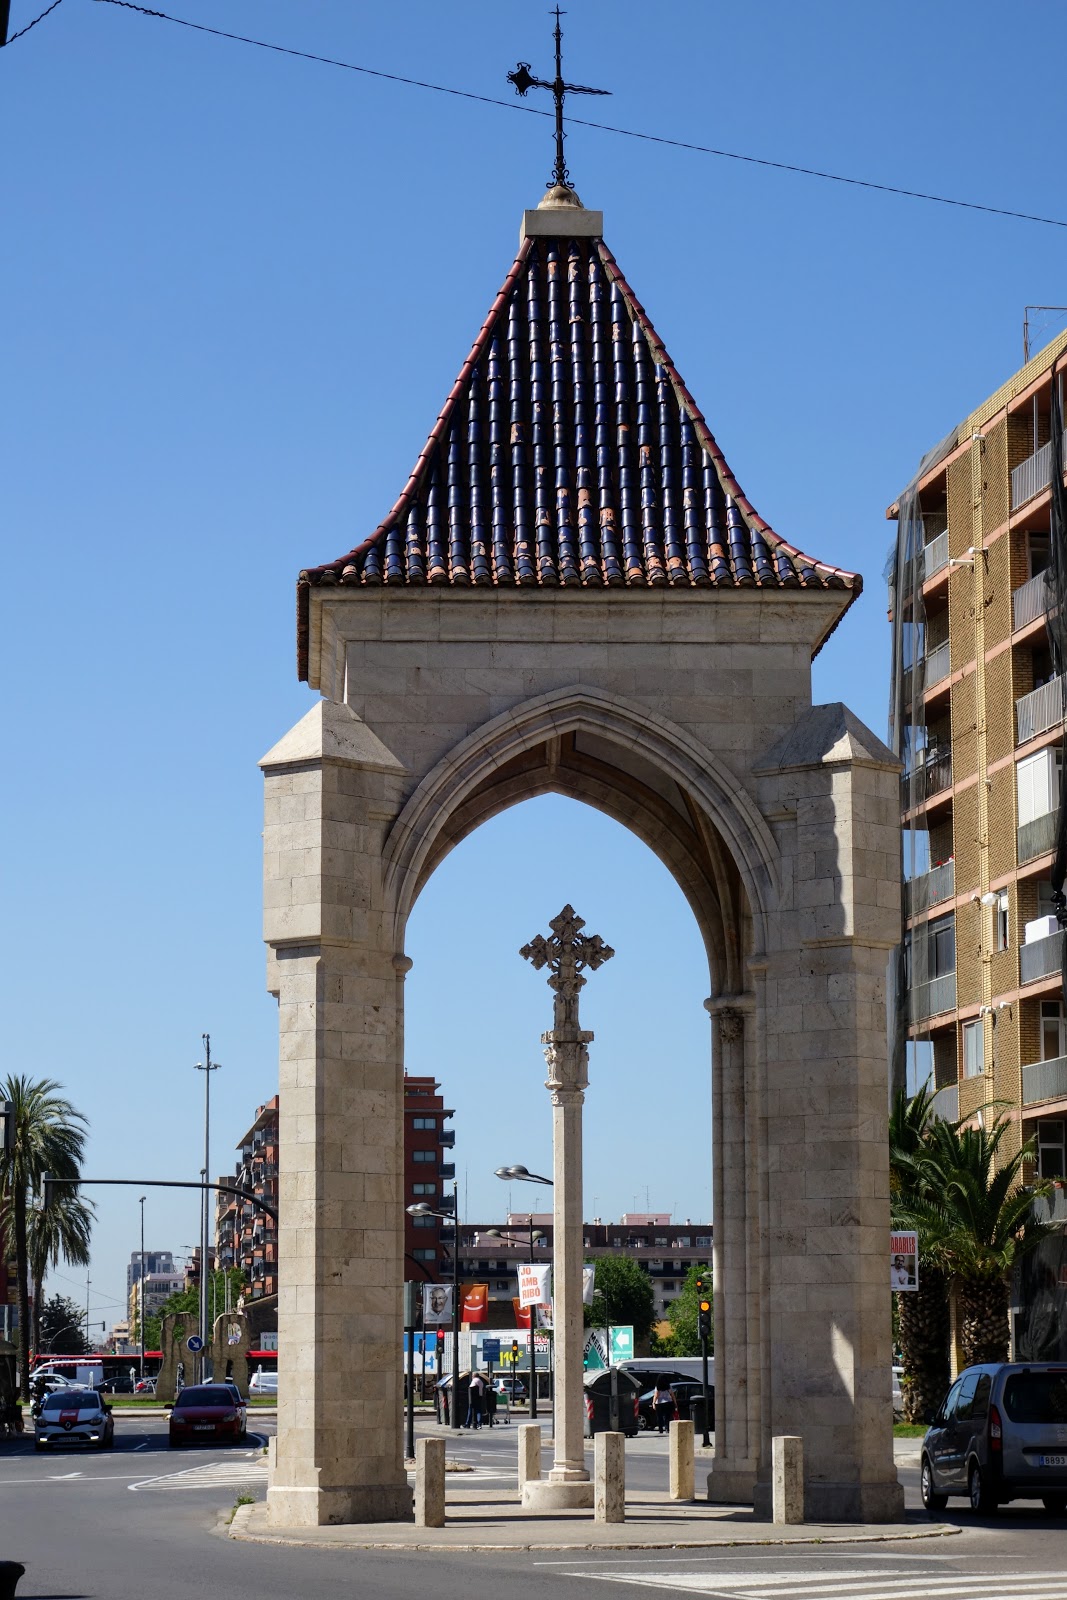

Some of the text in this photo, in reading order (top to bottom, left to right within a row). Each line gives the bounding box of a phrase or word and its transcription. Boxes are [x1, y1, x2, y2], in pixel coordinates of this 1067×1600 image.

[521, 1267, 532, 1276] JO
[522, 1277, 538, 1288] AMB
[522, 1287, 540, 1300] RIBÓ
[1045, 1456, 1065, 1464] 8893
